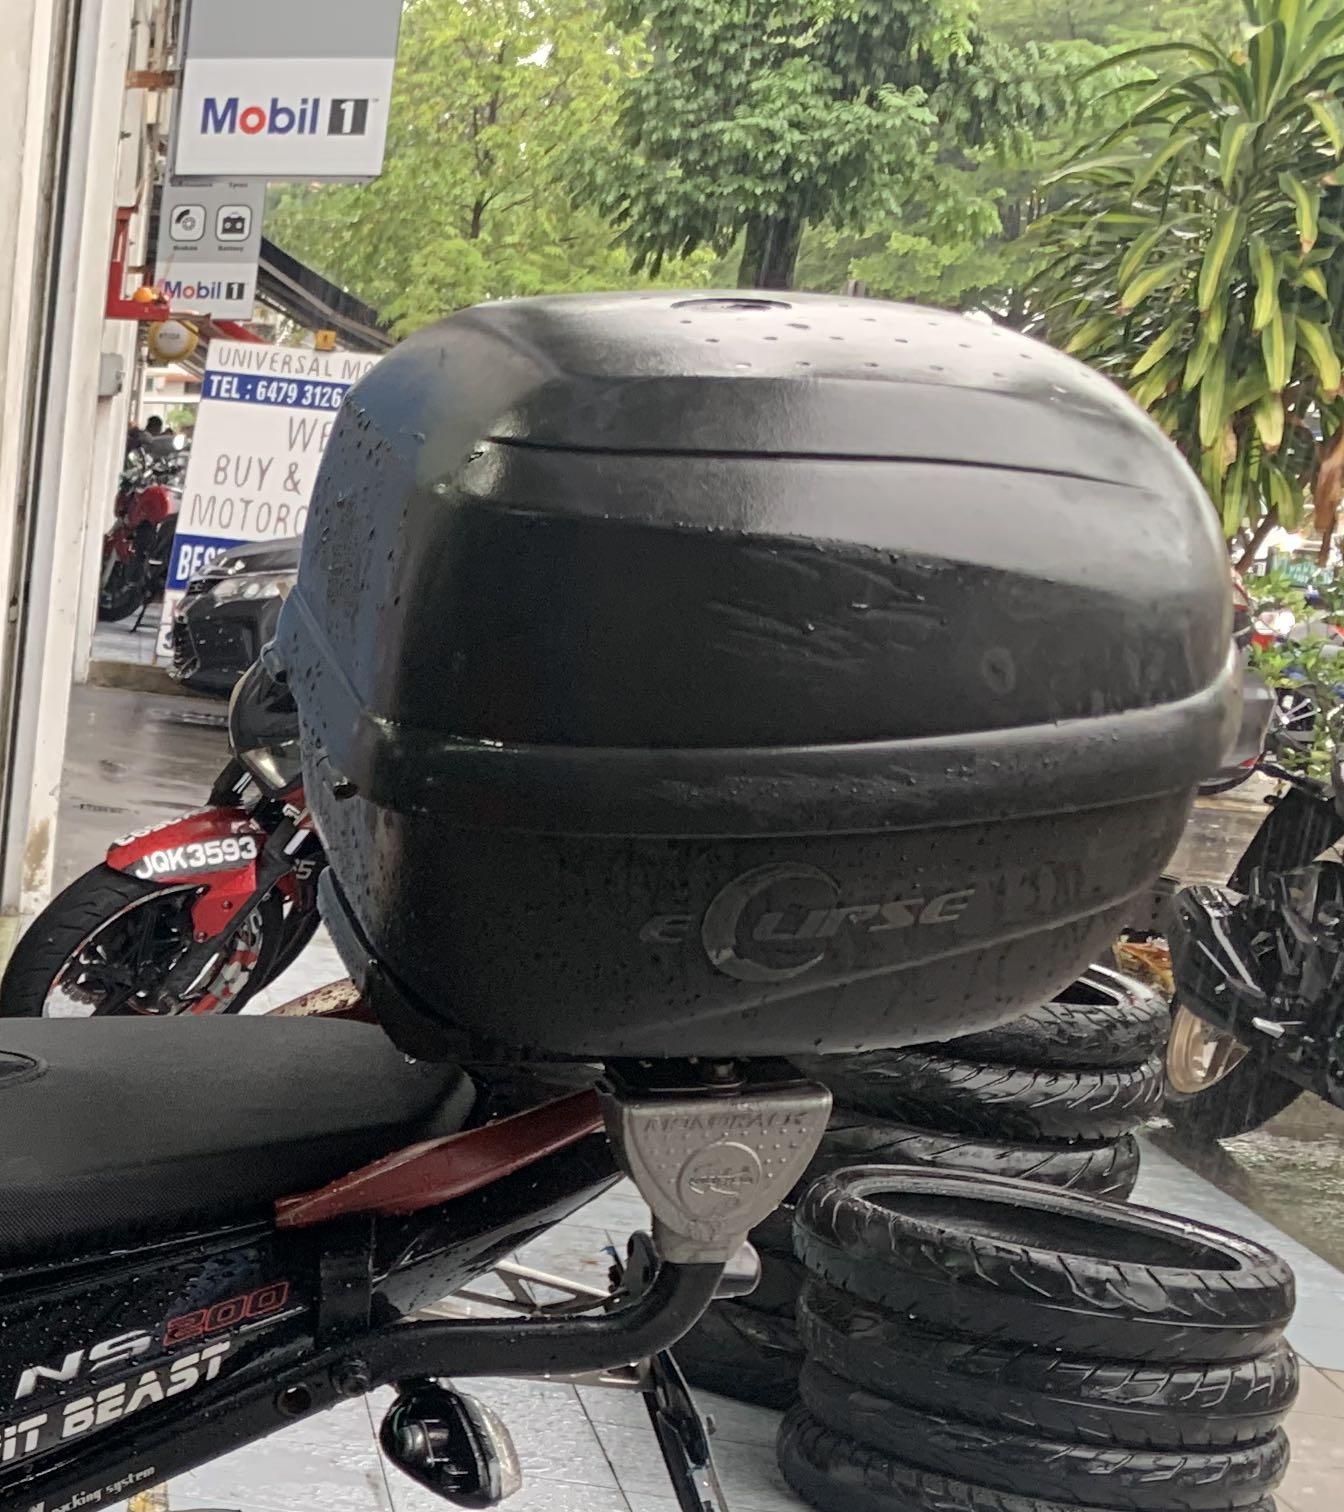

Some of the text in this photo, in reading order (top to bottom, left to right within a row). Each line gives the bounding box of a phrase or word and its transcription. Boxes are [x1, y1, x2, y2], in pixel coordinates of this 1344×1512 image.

[200, 98, 320, 135] Mobil
[164, 281, 221, 299] Mobil
[218, 346, 332, 378] UNIVERSAL
[210, 375, 240, 399] TEL
[256, 380, 298, 404] 6479
[301, 384, 343, 408] 3126
[214, 454, 301, 496] BUY &
[135, 836, 258, 880] JQK3593
[15, 1281, 290, 1400] NS 200
[61, 1342, 232, 1439] BEAST
